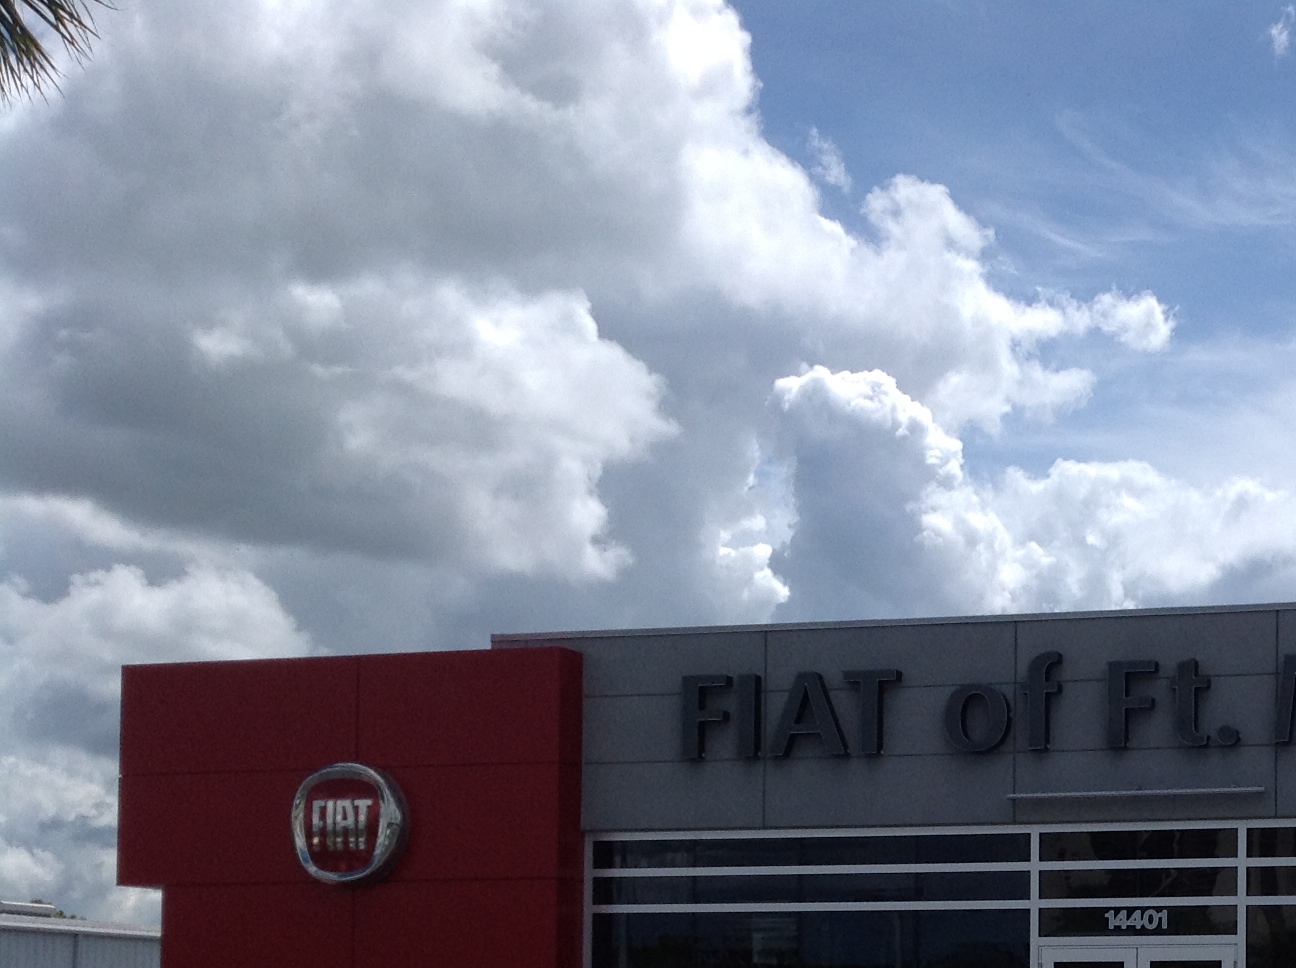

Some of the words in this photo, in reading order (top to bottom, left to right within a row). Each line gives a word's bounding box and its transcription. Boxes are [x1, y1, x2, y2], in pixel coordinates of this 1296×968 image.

[681, 669, 901, 759] FIAT
[943, 651, 1061, 752] of
[1107, 658, 1240, 748] Ft.
[312, 798, 373, 851] FIAT
[1105, 909, 1169, 930] 14401
